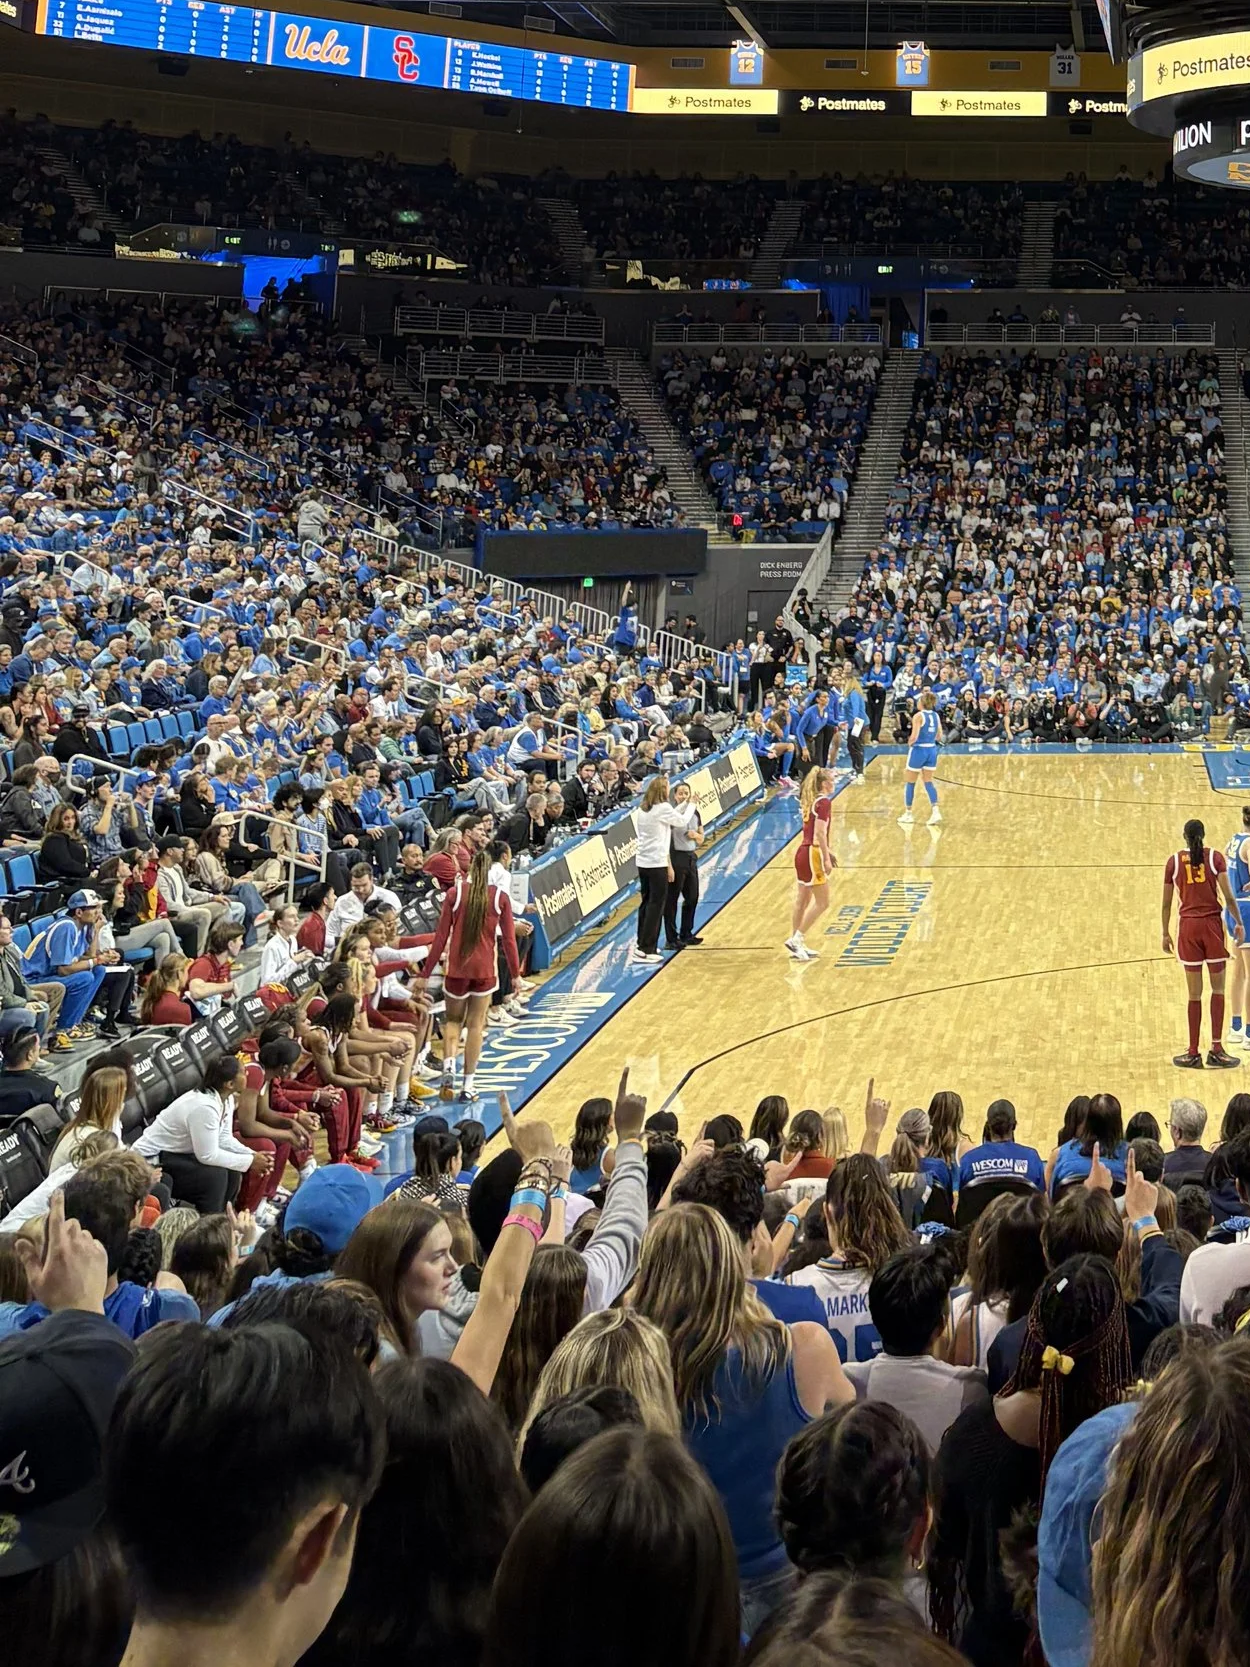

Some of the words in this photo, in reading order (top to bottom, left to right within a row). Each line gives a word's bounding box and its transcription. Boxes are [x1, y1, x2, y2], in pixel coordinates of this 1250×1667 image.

[285, 23, 350, 66] Ucla
[738, 58, 755, 73] 12
[905, 61, 922, 75] 15
[1058, 62, 1073, 75] 31
[686, 96, 751, 109] Postmates
[818, 97, 886, 111] Postmates
[956, 98, 1021, 112] Postmates
[760, 570, 782, 578] PRESS
[1185, 862, 1206, 885] 13
[542, 882, 577, 918] Postmates
[244, 997, 264, 1012] READY
[217, 1010, 237, 1029] READY
[190, 1026, 210, 1044] READY
[161, 1042, 184, 1060] READY
[971, 1158, 1014, 1171] WESCOM
